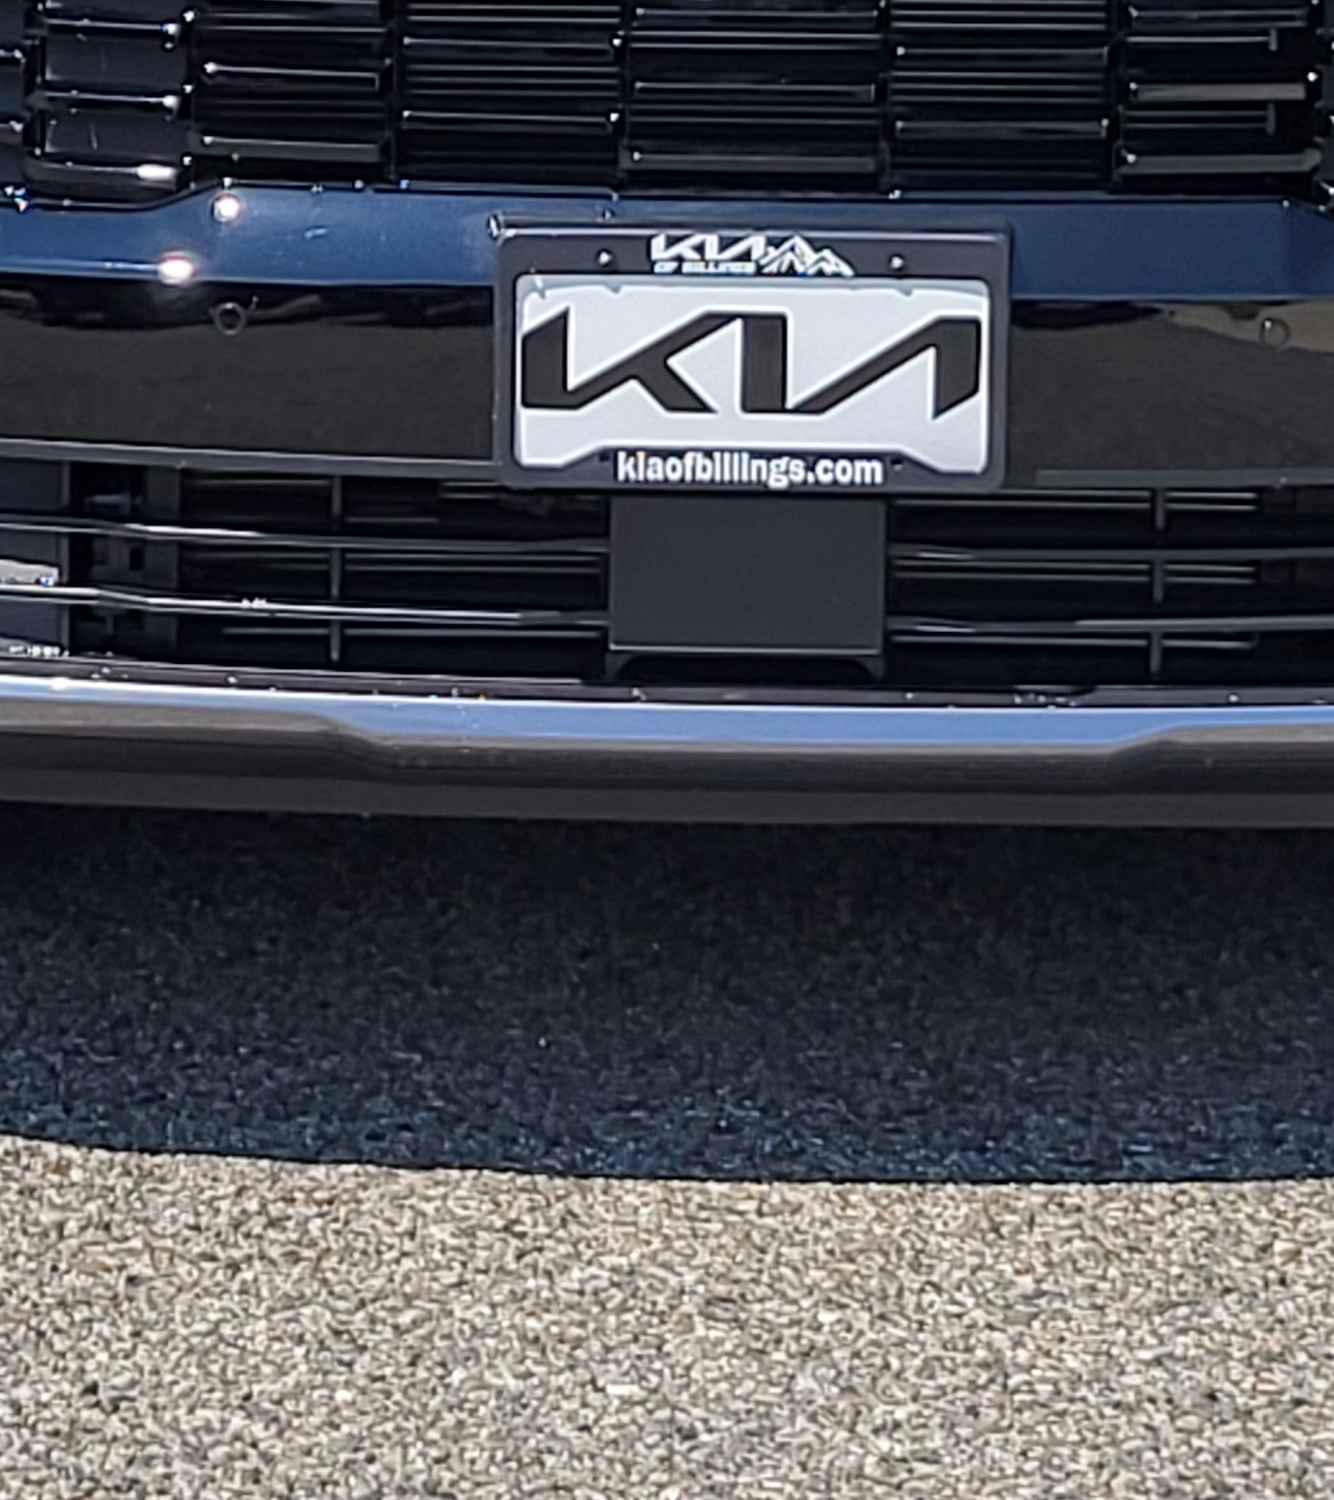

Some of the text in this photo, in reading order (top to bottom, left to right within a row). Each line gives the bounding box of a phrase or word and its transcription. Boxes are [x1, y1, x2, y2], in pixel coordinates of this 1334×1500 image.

[651, 234, 767, 260] KIA
[522, 306, 982, 420] KIA
[617, 451, 884, 489] kiaofbillings.com
